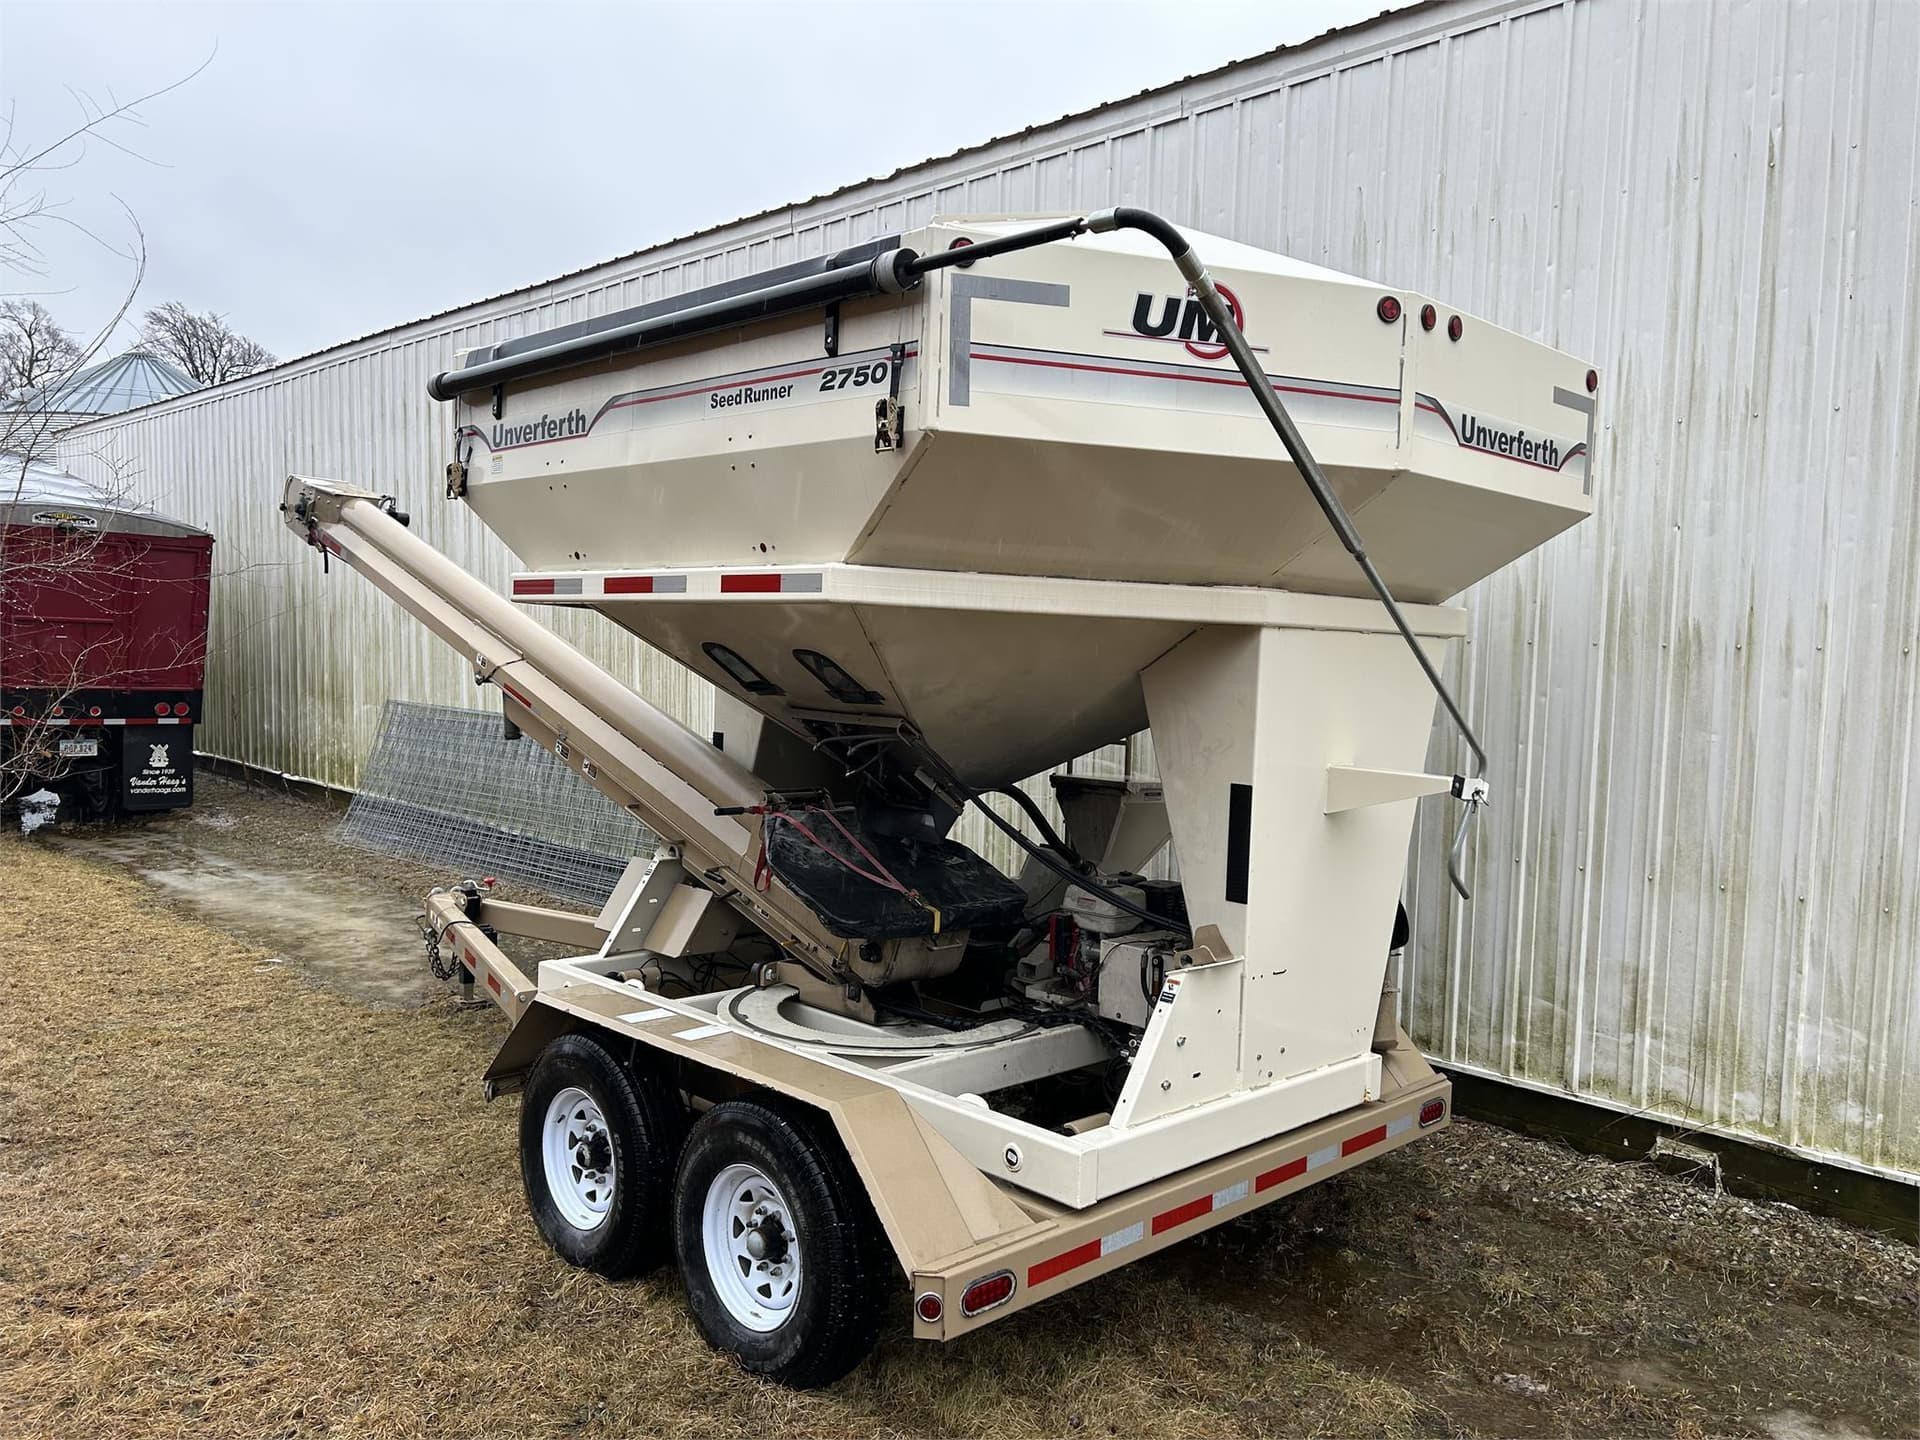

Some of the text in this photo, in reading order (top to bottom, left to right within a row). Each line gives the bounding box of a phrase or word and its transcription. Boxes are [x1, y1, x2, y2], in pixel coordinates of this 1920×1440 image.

[819, 362, 888, 392] 2750
[744, 384, 794, 404] Runner
[493, 408, 587, 448] Unverferth
[1461, 413, 1559, 467] Unverferth
[130, 775, 187, 788] Vander Haag's
